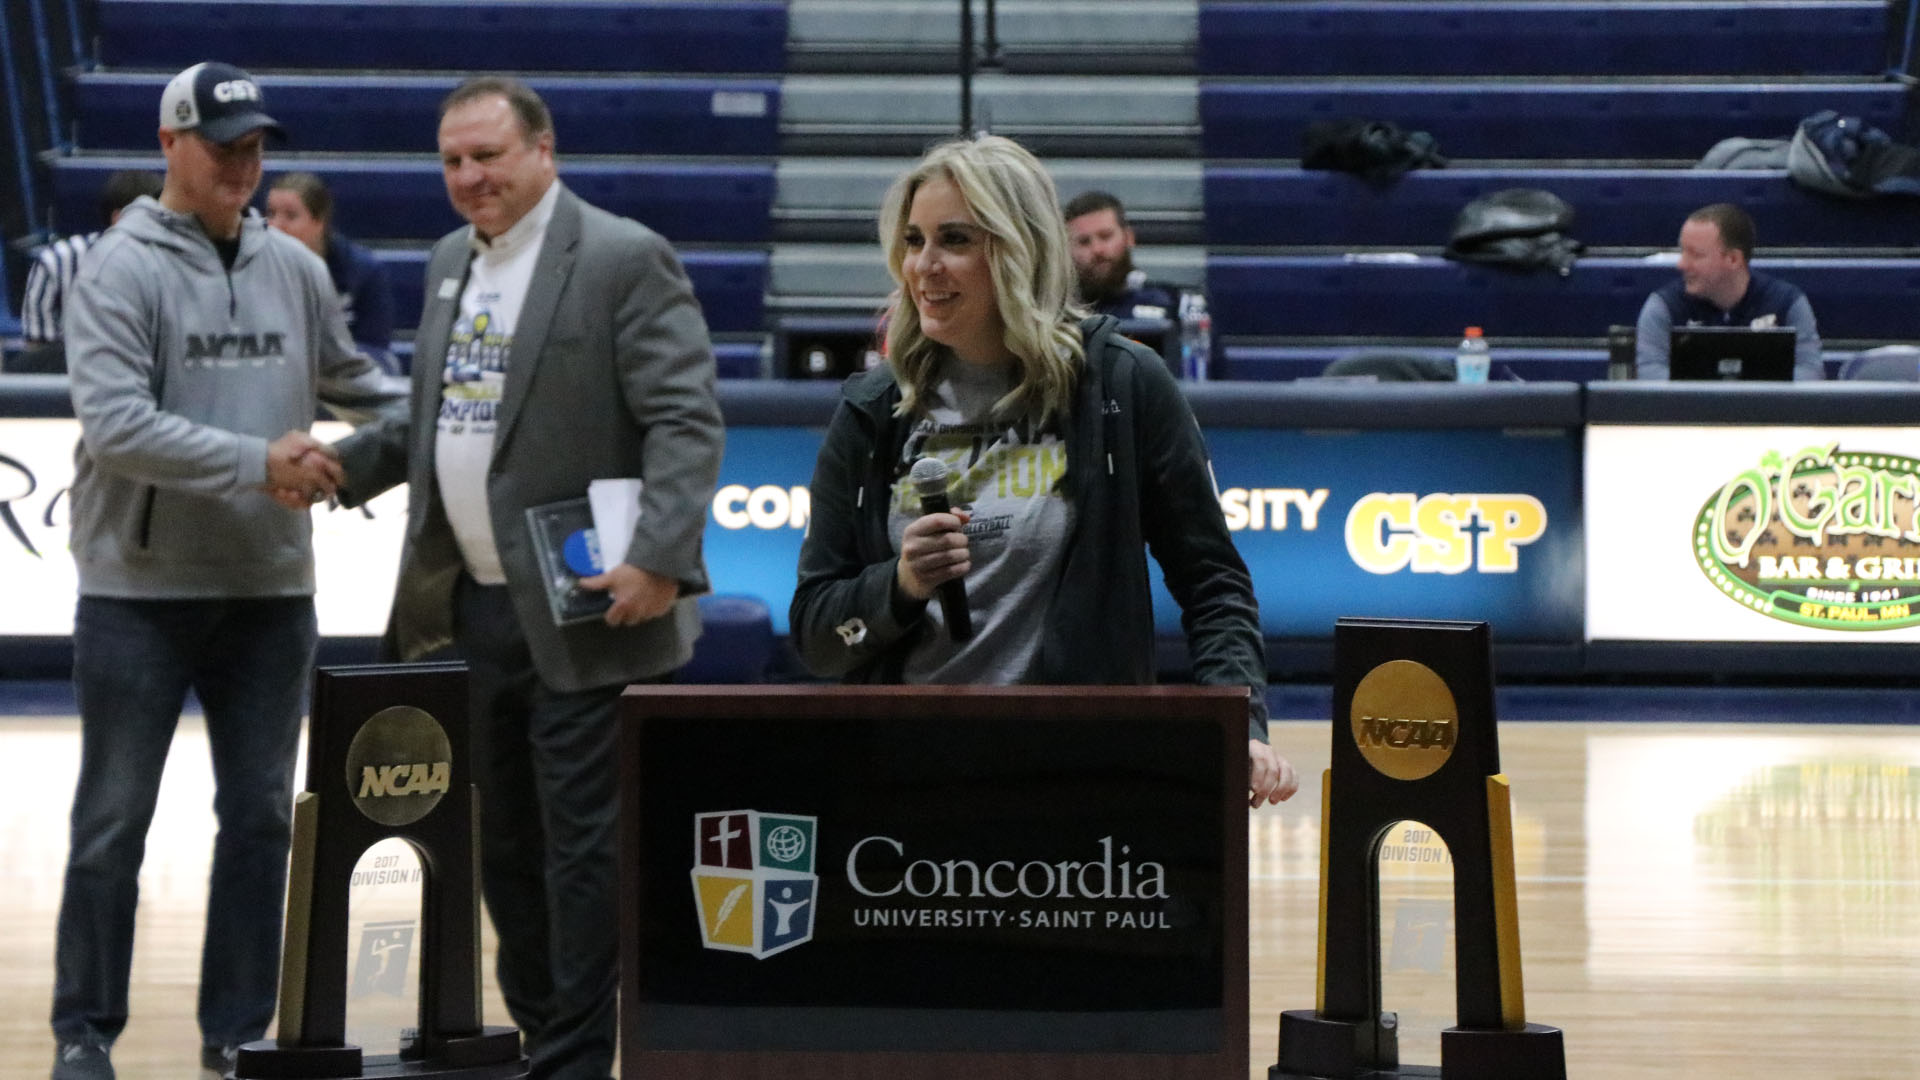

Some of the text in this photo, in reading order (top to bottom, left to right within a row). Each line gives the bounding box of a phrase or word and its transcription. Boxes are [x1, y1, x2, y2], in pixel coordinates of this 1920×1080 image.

[1710, 441, 1920, 568] O'Gar
[962, 518, 1011, 535] OLLEYBALL
[1345, 492, 1548, 575] CSP
[1757, 554, 1920, 581] BAR & GRI
[1806, 586, 1857, 603] SINCE
[1800, 601, 1826, 619] ST.
[1880, 603, 1911, 620] MN
[1359, 715, 1455, 751] NCAA
[358, 761, 450, 798] NCAA
[1403, 829, 1432, 844] 2017
[374, 855, 400, 869] 2017
[1381, 845, 1442, 863] DIVISION
[846, 835, 1171, 899] Concordia
[352, 869, 409, 886] DIVISION
[1105, 911, 1172, 929] PAUL
